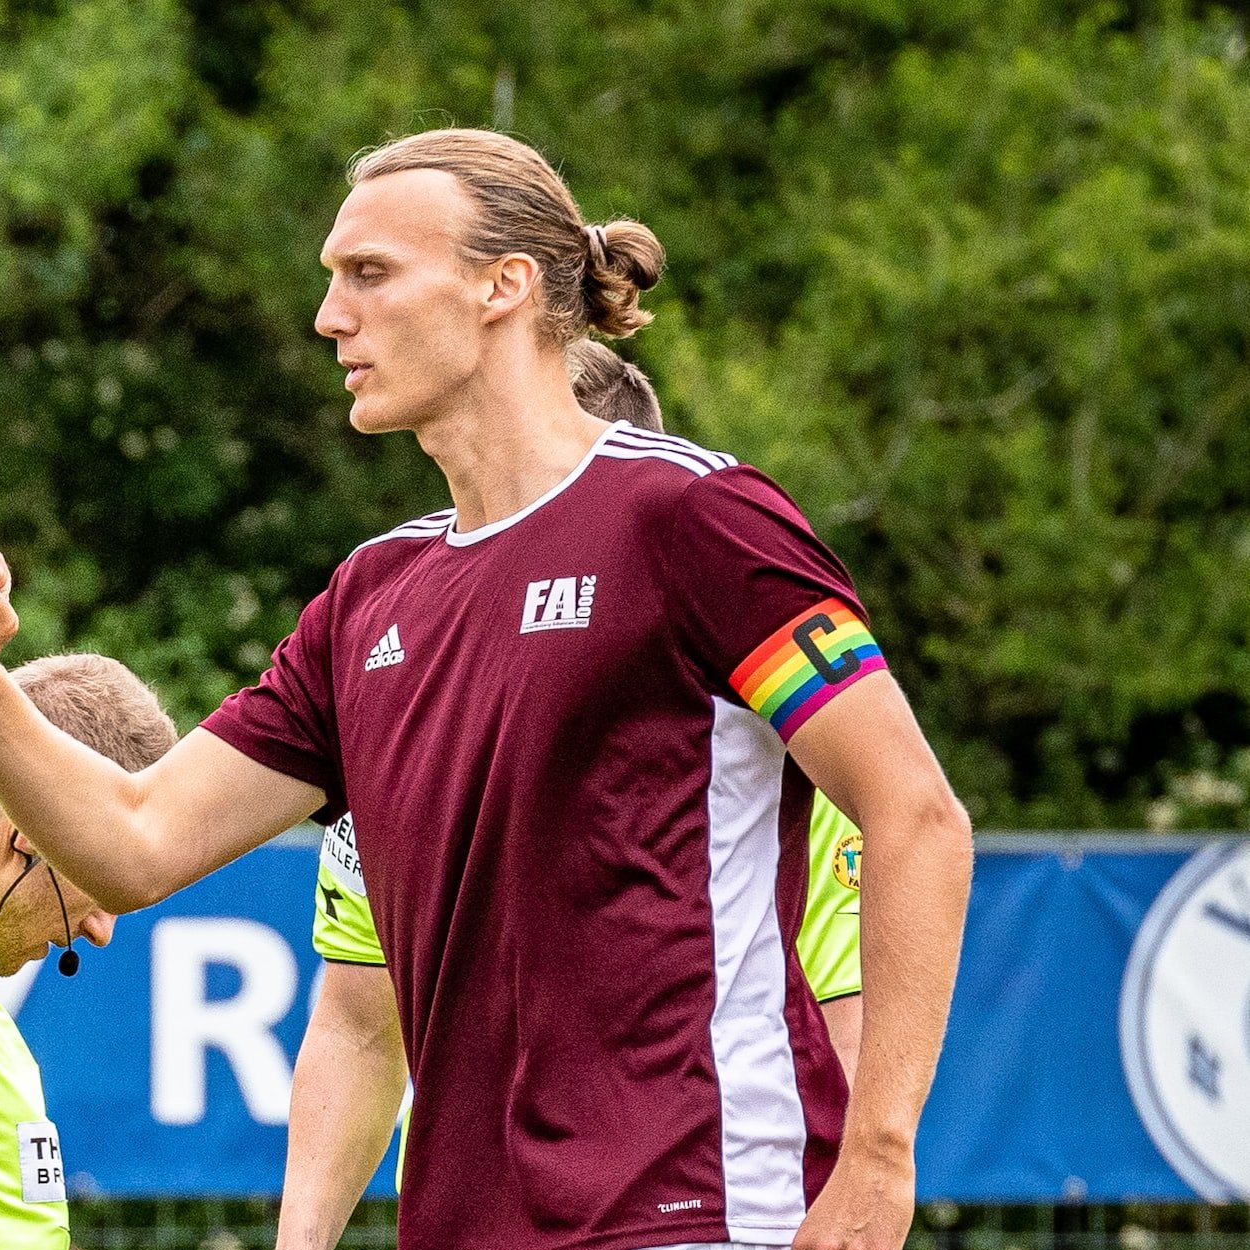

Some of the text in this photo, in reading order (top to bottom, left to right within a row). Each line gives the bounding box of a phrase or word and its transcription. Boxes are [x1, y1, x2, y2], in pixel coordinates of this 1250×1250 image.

[521, 576, 577, 624] FA
[576, 575, 597, 618] 2000
[365, 649, 405, 671] adidas
[792, 612, 862, 685] C
[325, 831, 362, 878] ILLER
[152, 916, 326, 1126] R
[659, 1199, 702, 1214] CLIMALITE
